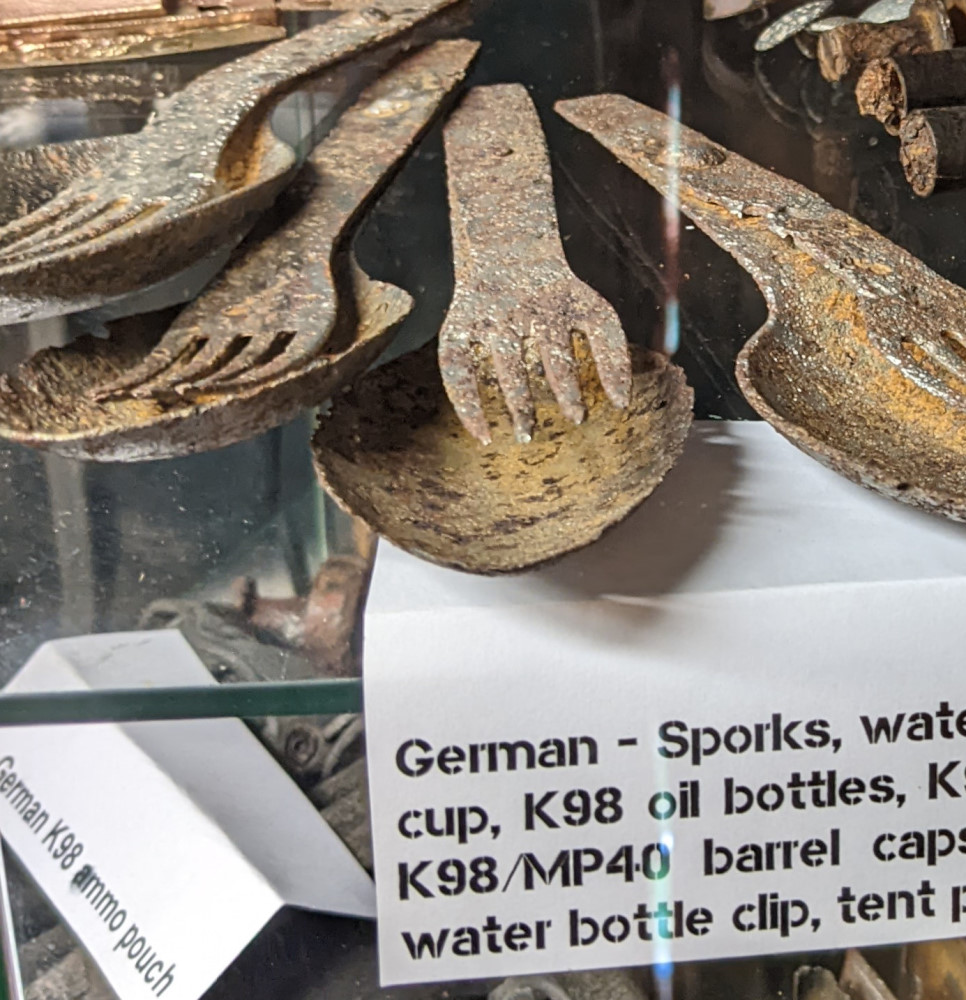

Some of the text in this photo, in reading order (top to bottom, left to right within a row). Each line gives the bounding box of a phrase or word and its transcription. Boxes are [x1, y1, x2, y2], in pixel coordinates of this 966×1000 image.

[396, 736, 598, 777] German
[618, 738, 637, 746] -
[656, 713, 841, 765] Sporks,
[398, 806, 500, 843] cup,
[525, 787, 623, 830] K98
[648, 781, 699, 819] oil
[724, 771, 905, 815] bottles,
[398, 843, 670, 900] K98/MP40
[704, 829, 840, 876] barrel
[41, 818, 84, 870] K98
[69, 863, 128, 931] ammo
[112, 923, 177, 998] pouch
[402, 916, 551, 959] water
[569, 901, 713, 946] bottle
[732, 893, 820, 936] clip,
[837, 881, 935, 923] tent
